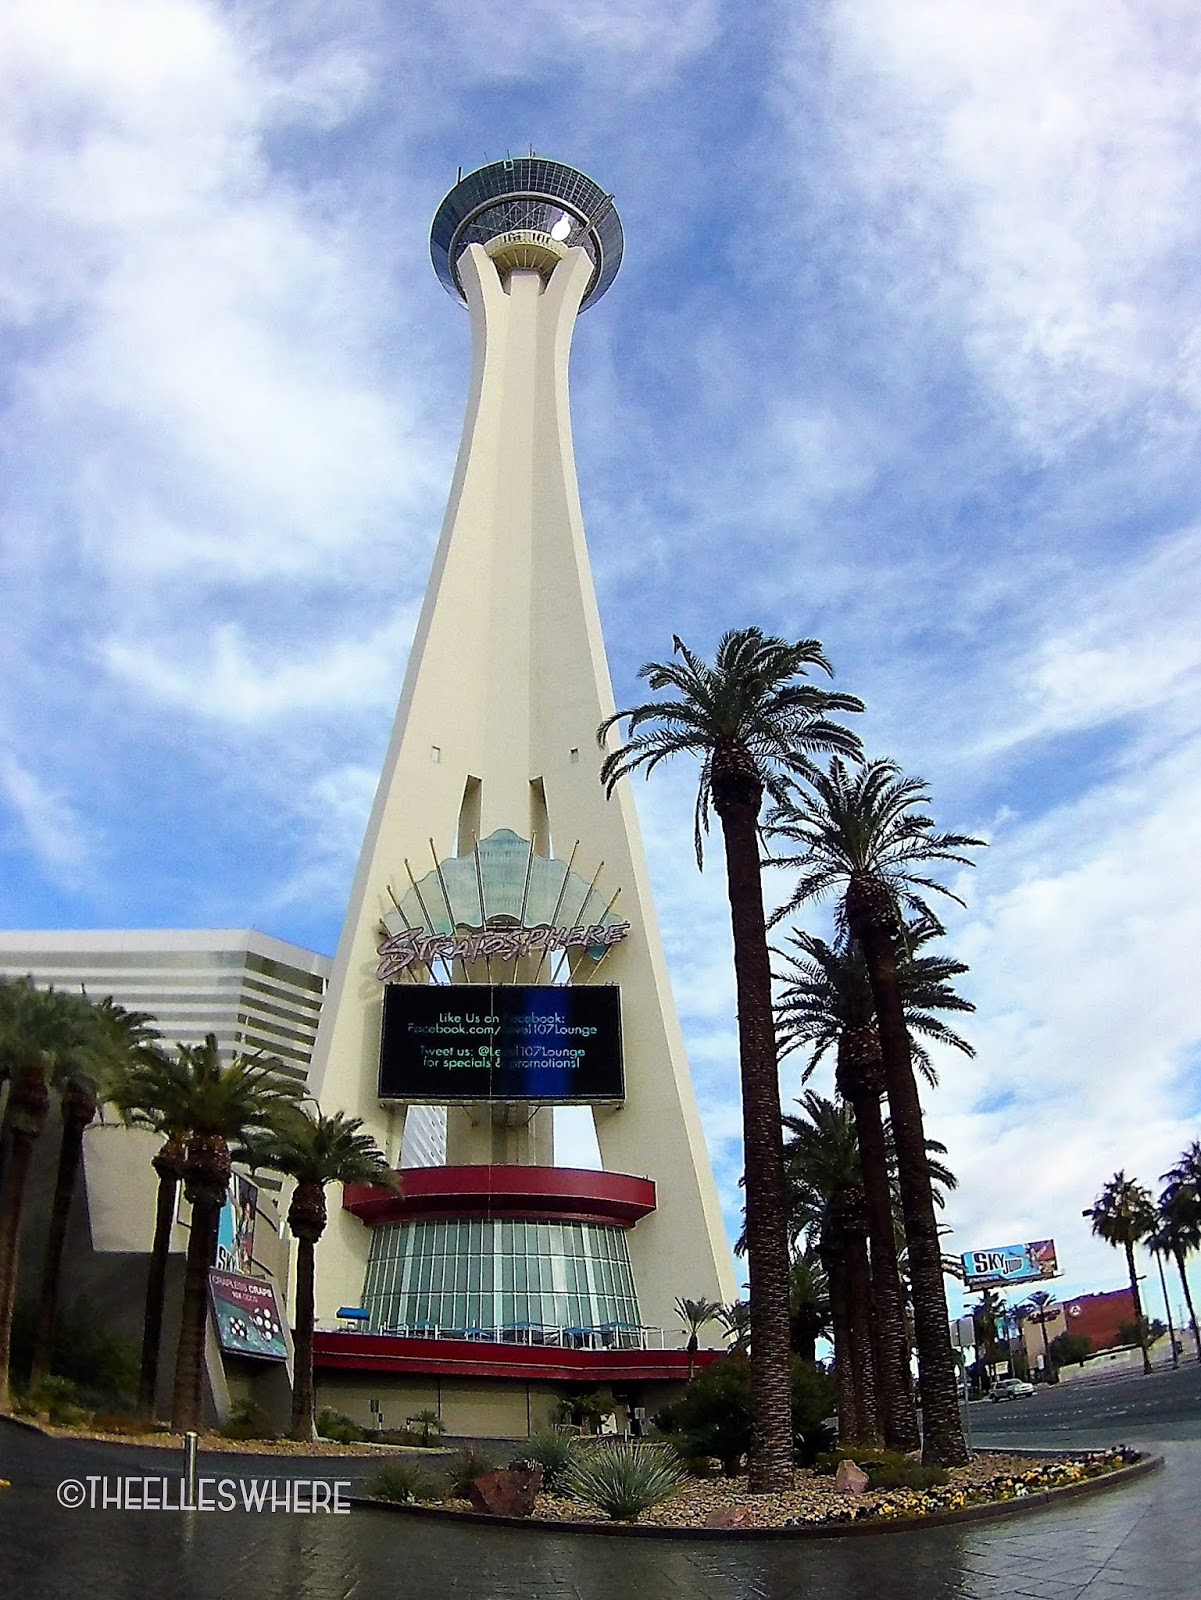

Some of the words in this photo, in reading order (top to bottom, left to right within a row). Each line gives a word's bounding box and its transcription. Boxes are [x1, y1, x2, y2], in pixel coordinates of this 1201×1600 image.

[439, 1012, 461, 1023] Like
[466, 1013, 480, 1023] Us
[484, 1015, 500, 1023] on
[507, 1012, 565, 1023] acebook:
[408, 1023, 598, 1037] Facebook.com/vel107Lounge
[420, 1046, 454, 1056] Tweet
[457, 1048, 474, 1056] us:
[478, 1045, 586, 1057] @Lel107Lounge
[423, 1056, 439, 1067] for
[443, 1057, 492, 1069] specials
[973, 1252, 1004, 1273] SKY
